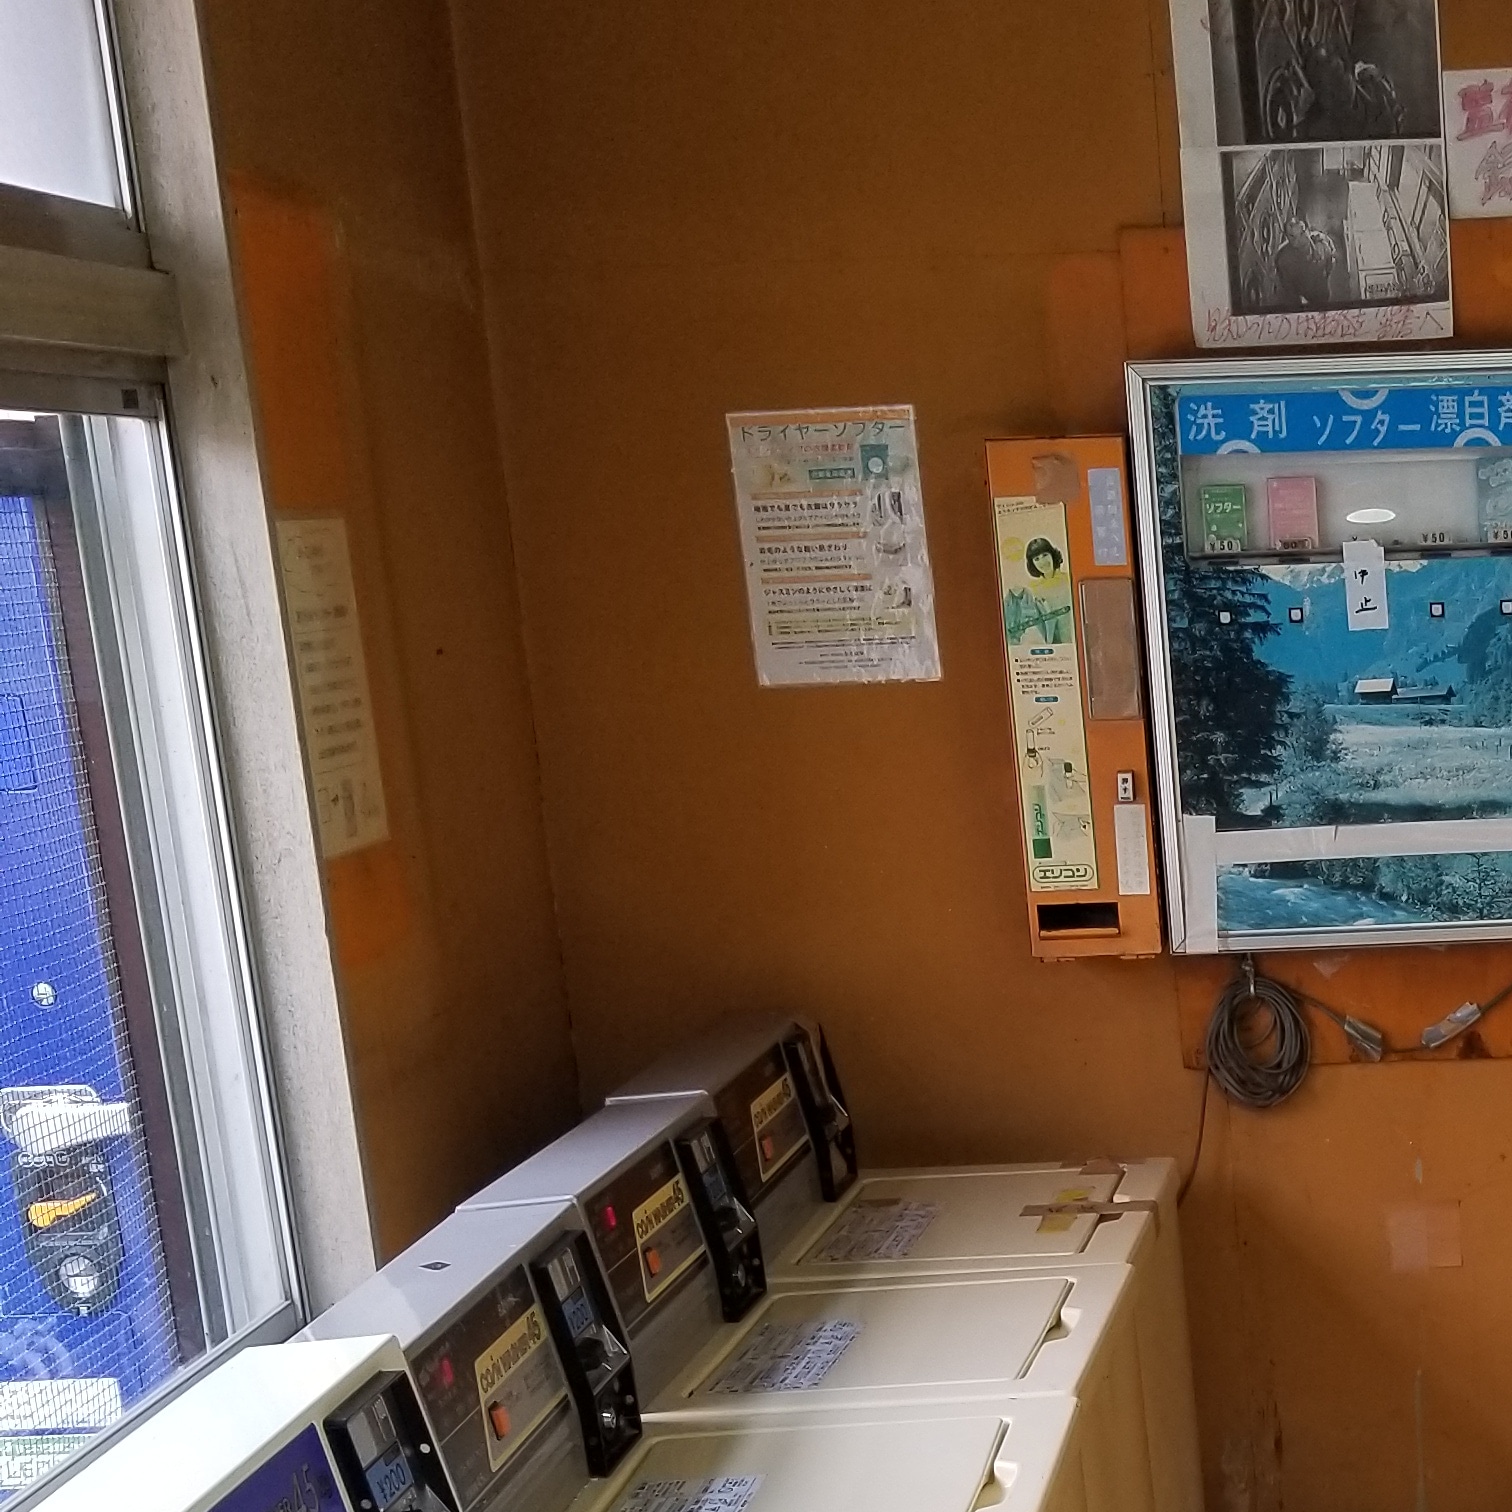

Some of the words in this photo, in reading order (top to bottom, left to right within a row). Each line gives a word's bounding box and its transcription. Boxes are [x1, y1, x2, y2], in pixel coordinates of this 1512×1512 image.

[741, 420, 905, 443] ドライヤーソフター
[1187, 399, 1288, 441] 洗剤
[1312, 409, 1421, 447] ソフター
[1206, 502, 1242, 514] ソフター
[1422, 532, 1445, 544] ¥50
[1354, 569, 1378, 614] 中止
